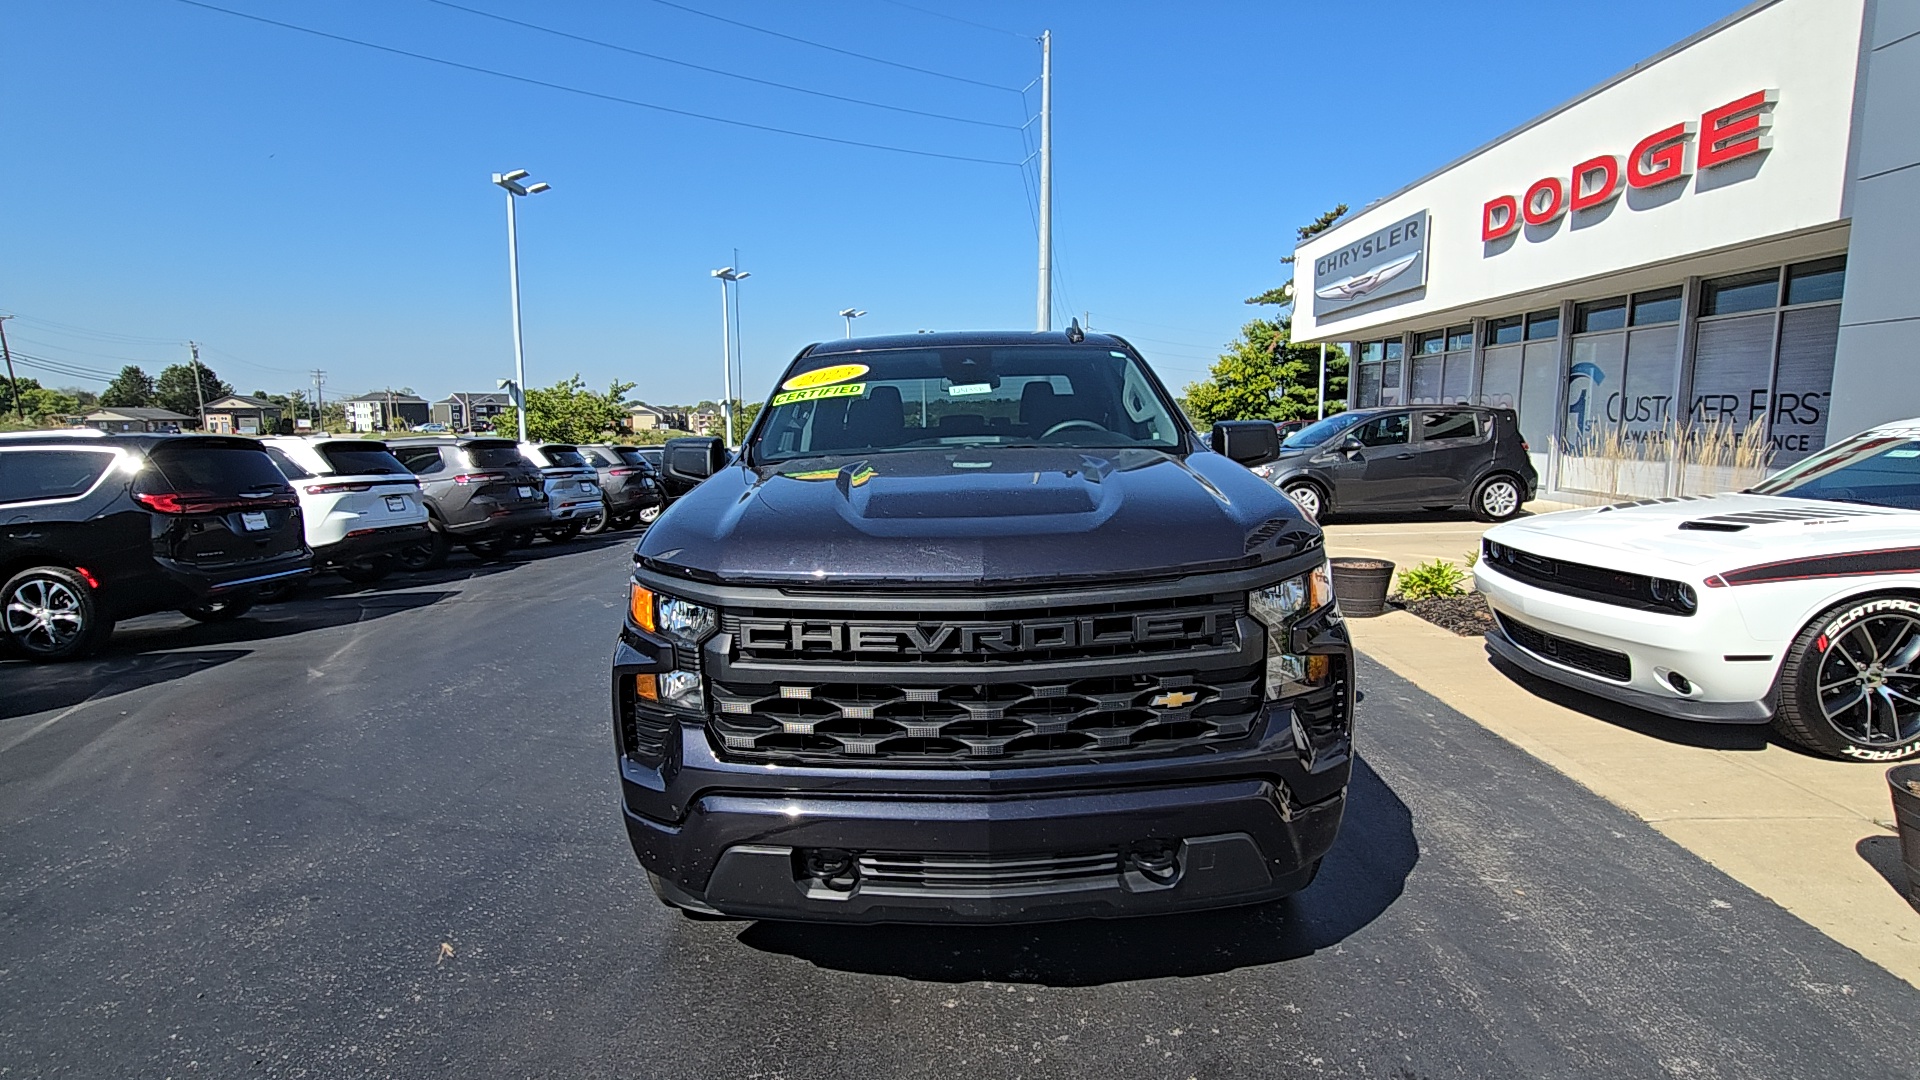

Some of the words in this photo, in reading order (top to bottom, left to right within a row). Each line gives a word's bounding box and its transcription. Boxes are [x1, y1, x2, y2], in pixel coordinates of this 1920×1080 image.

[1482, 89, 1768, 242] DODGE
[1317, 220, 1419, 277] CHRYSLER
[776, 385, 861, 403] CERTIFIED
[740, 609, 1235, 655] CHEVROLET
[1825, 599, 1920, 640] SCATPAC
